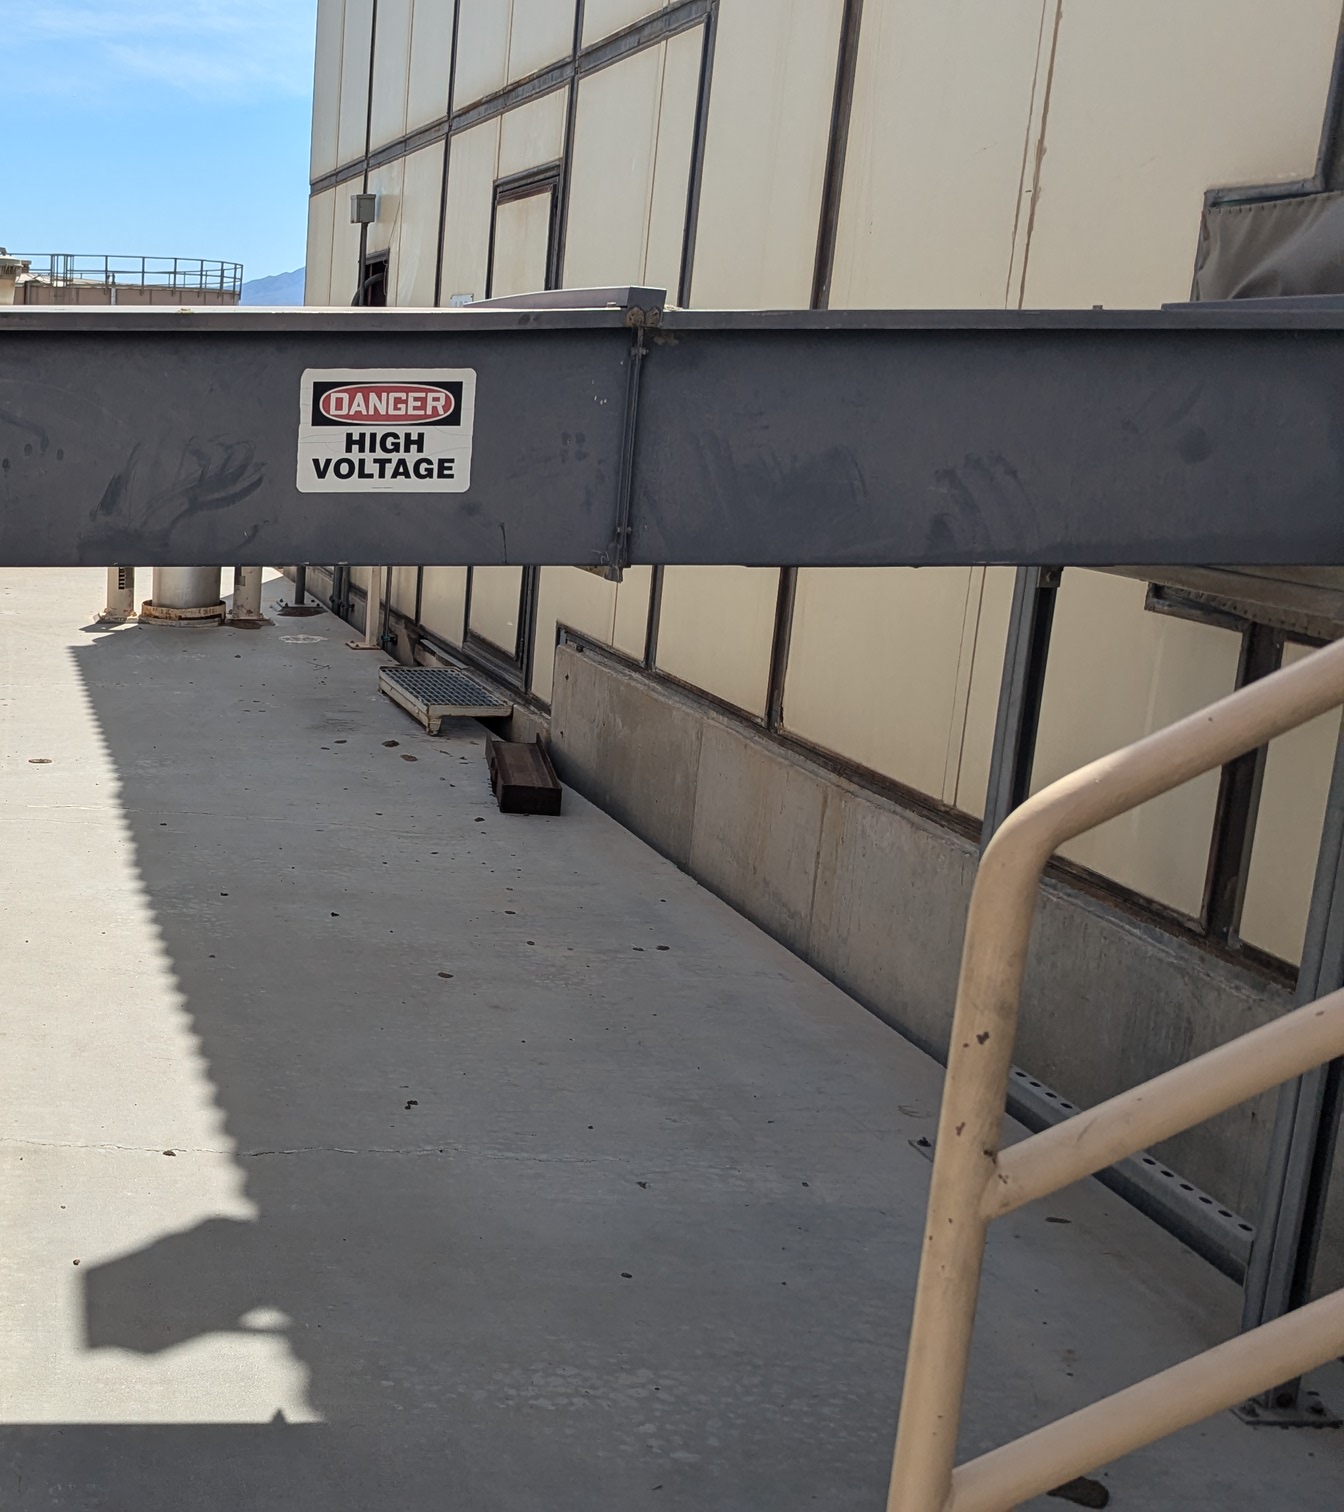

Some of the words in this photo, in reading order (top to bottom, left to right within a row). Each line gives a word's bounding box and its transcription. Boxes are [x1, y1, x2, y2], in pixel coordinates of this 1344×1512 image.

[329, 392, 447, 416] DANGER
[344, 431, 425, 454] HIGH
[311, 457, 456, 480] VOLTAGE
